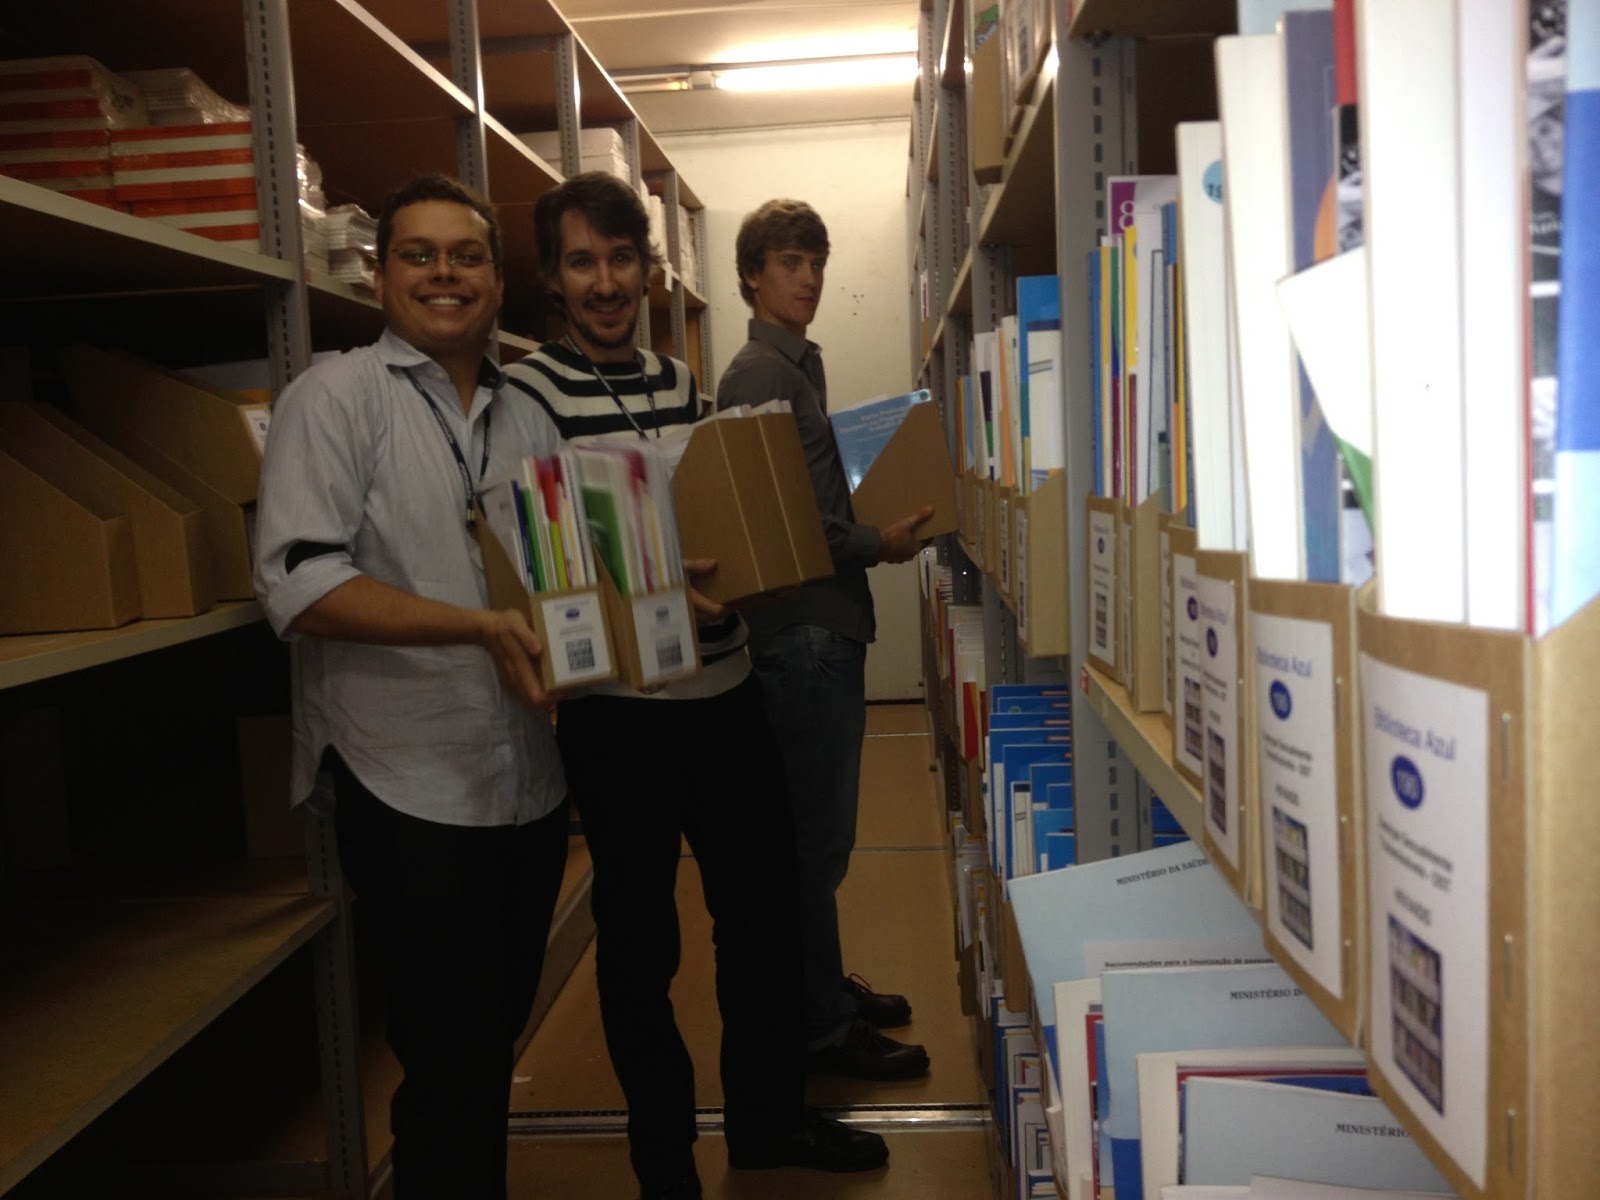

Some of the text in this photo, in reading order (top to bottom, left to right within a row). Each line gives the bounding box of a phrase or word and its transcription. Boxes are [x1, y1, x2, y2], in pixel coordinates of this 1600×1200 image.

[1426, 728, 1456, 761] Azul
[1116, 868, 1167, 886] MINISTÉRIO
[1168, 864, 1181, 874] DA
[1104, 960, 1162, 969] Recomendações
[1163, 960, 1180, 968] para
[1230, 987, 1291, 1001] MINISTÉRIO
